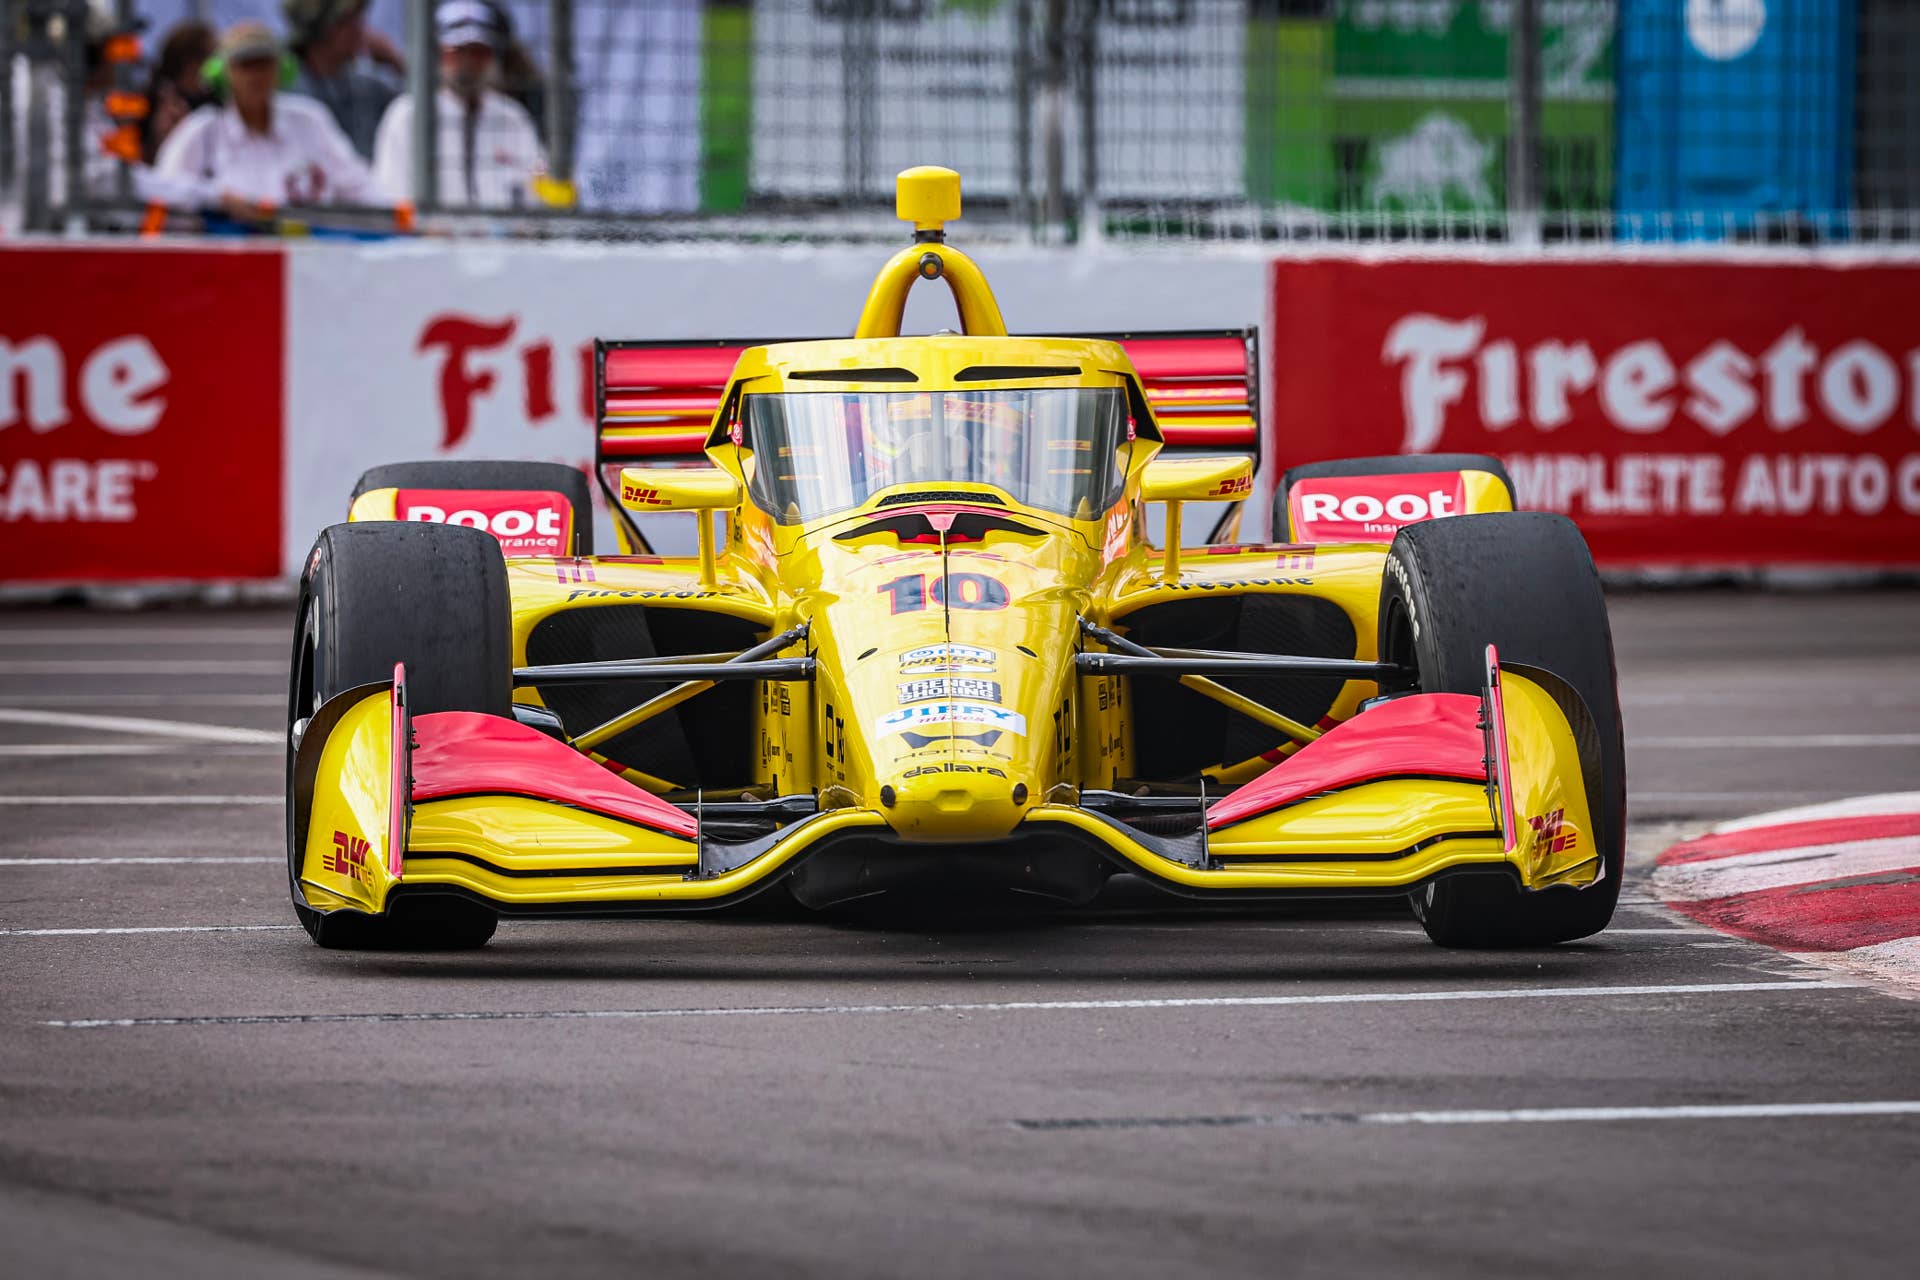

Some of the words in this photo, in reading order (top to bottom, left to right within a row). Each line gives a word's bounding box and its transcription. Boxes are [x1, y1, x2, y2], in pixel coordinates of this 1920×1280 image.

[1505, 454, 1725, 515] MPLETE
[1734, 454, 1889, 515] AUTO
[623, 486, 662, 505] DHL
[1302, 490, 1455, 521] Root
[877, 573, 1011, 616] 10
[1387, 554, 1421, 642] Firestone
[900, 655, 995, 668] INDYCAR
[938, 648, 986, 656] NTT
[899, 679, 994, 693] TRENCH
[899, 686, 994, 702] SHORING
[885, 704, 1012, 725] JIFFY
[902, 762, 1008, 780] dallara
